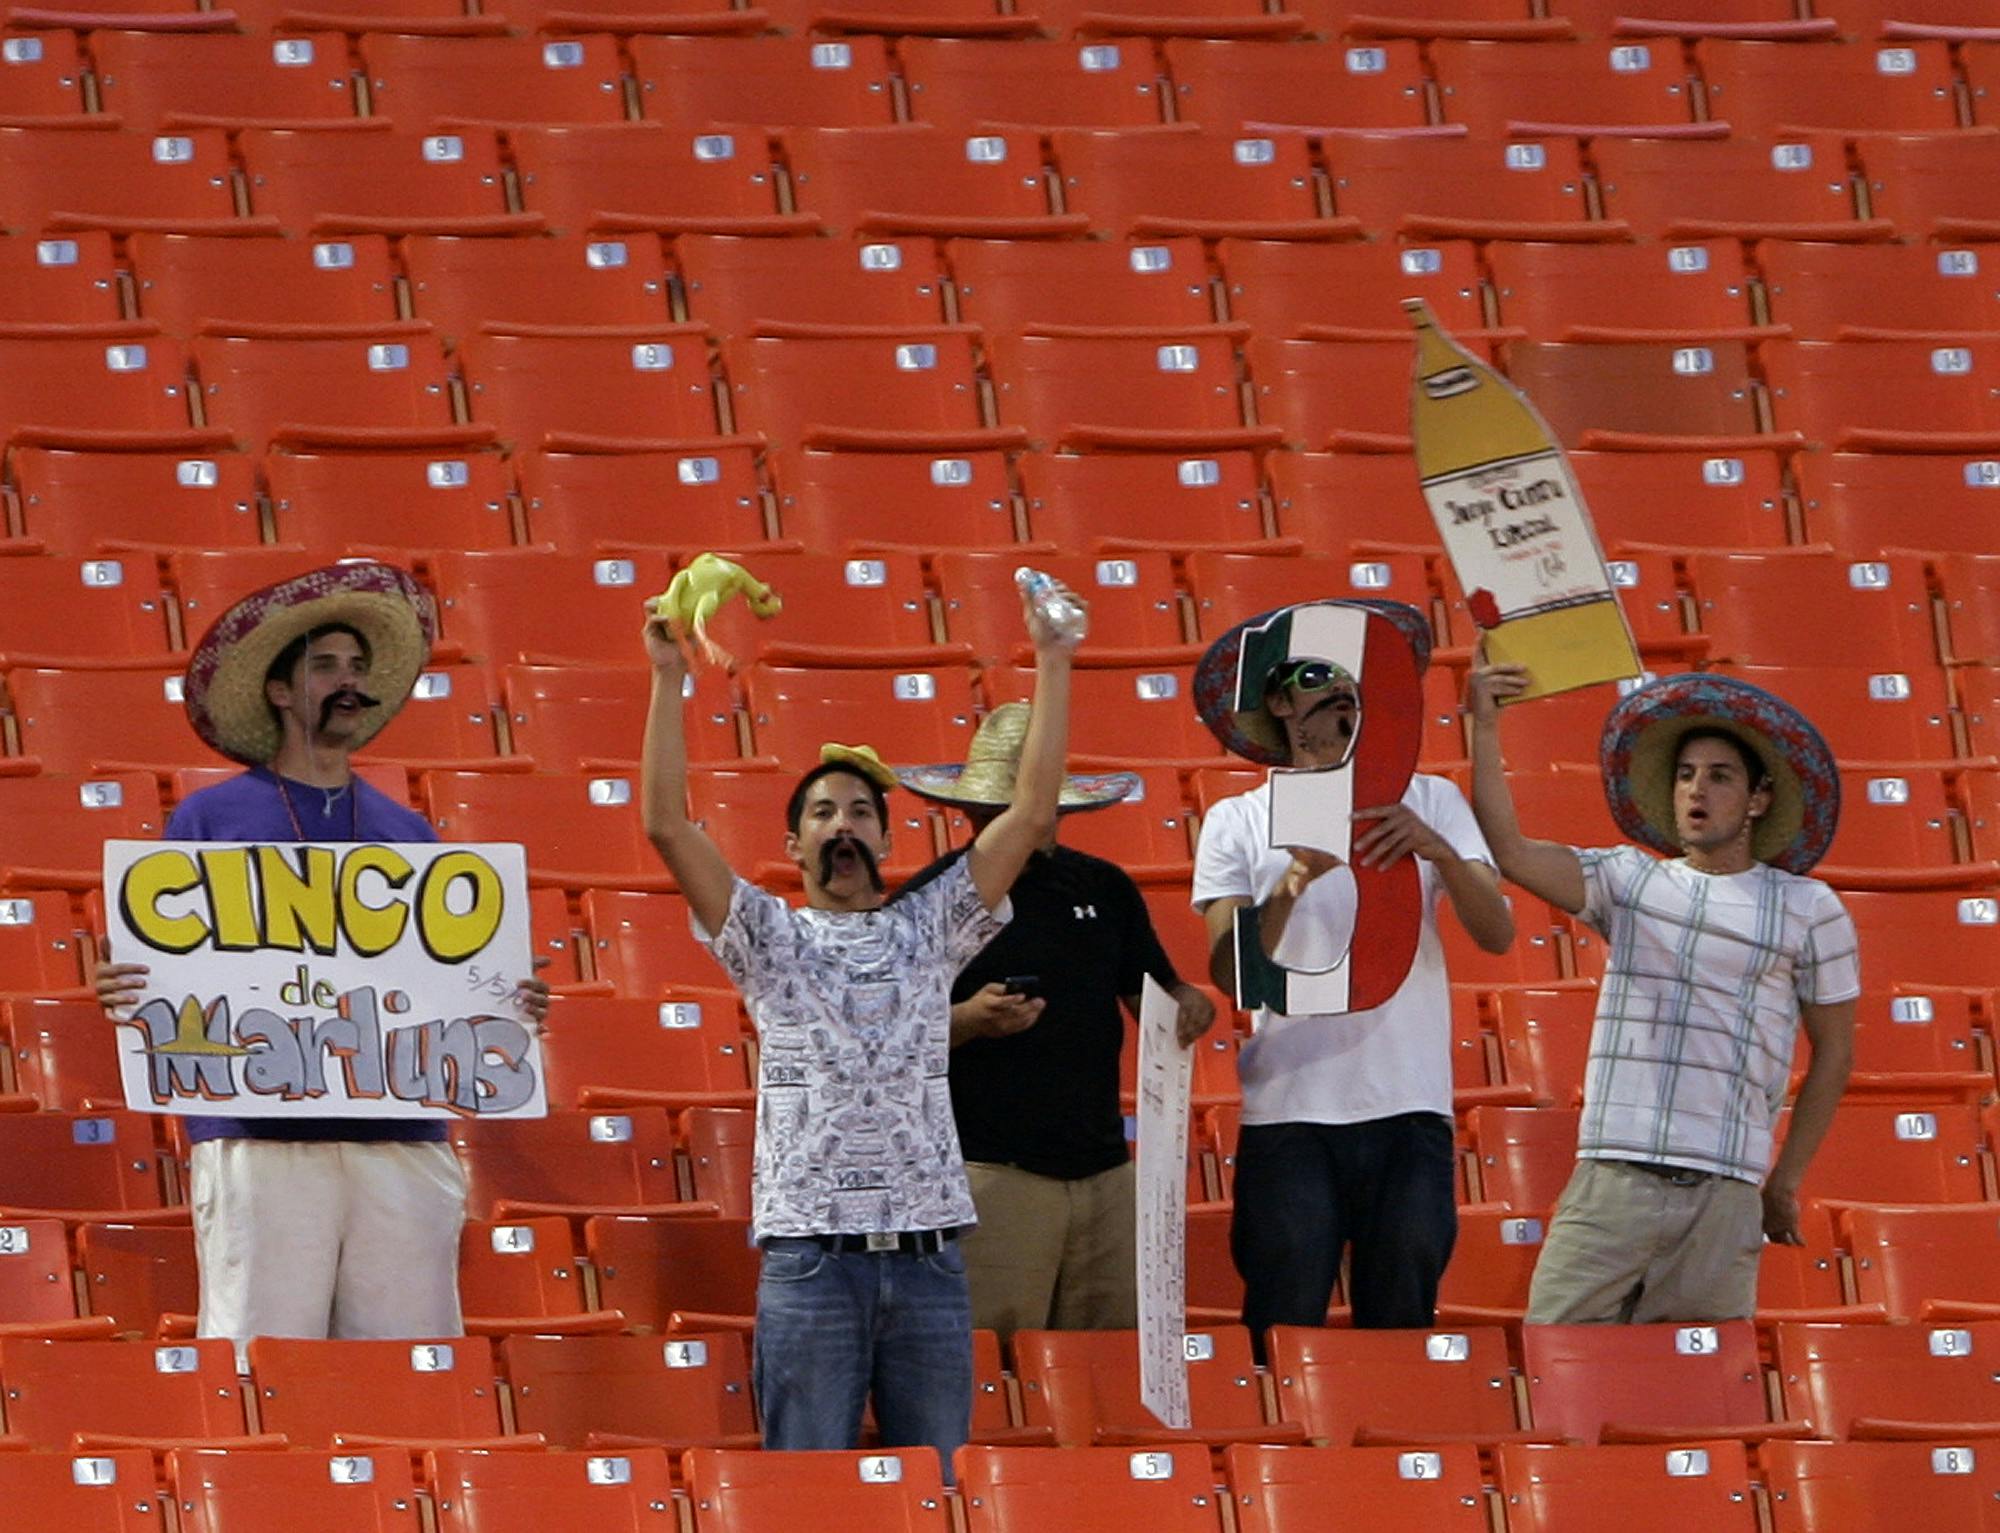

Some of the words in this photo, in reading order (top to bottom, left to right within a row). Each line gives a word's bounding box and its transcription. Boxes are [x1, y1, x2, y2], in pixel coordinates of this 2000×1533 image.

[168, 139, 178, 158] 8
[436, 138, 447, 157] 9
[1516, 147, 1533, 164] 13
[1678, 250, 1695, 267] 13
[1950, 254, 1966, 271] 14
[1682, 350, 1704, 369] 13
[1944, 352, 1961, 369] 14
[191, 463, 201, 481] 7
[1714, 461, 1731, 480] 13
[1976, 464, 1995, 482] 14
[96, 563, 107, 582] 6
[608, 562, 619, 582] 8
[860, 562, 871, 582] 9
[1108, 563, 1125, 582] 10
[1364, 565, 1377, 584] 11
[1861, 565, 1878, 584] 13
[908, 676, 919, 696] 9
[1880, 676, 1898, 696] 13
[95, 785, 106, 804] 5
[604, 781, 614, 801] 7
[1879, 781, 1895, 799] 12
[6, 902, 18, 921] 4
[119, 844, 504, 964] CINCO
[1969, 900, 1986, 920] 12
[280, 964, 338, 1008] de
[675, 1005, 686, 1024] 6
[1904, 1000, 1920, 1019] 11
[117, 985, 536, 1117] Marlins
[88, 1121, 99, 1141] 3
[606, 1118, 616, 1137] 5
[1907, 1116, 1925, 1135] 10
[0, 1228, 14, 1252] 2
[507, 1228, 518, 1248] 4
[1516, 1221, 1527, 1240] 8
[1186, 1336, 1199, 1357] 6
[1442, 1337, 1452, 1357] 7
[1690, 1329, 1703, 1351] 8
[1944, 1333, 1955, 1354] 9
[170, 1349, 182, 1369] 2
[427, 1347, 438, 1369] 3
[680, 1343, 690, 1363] 4
[90, 1461, 98, 1480] 1
[345, 1459, 357, 1481] 2
[603, 1459, 615, 1480] 3
[874, 1459, 888, 1478] 4
[1146, 1454, 1157, 1476] 5
[1413, 1456, 1425, 1478] 6
[1681, 1451, 1692, 1472] 7
[1947, 1451, 1958, 1471] 8
